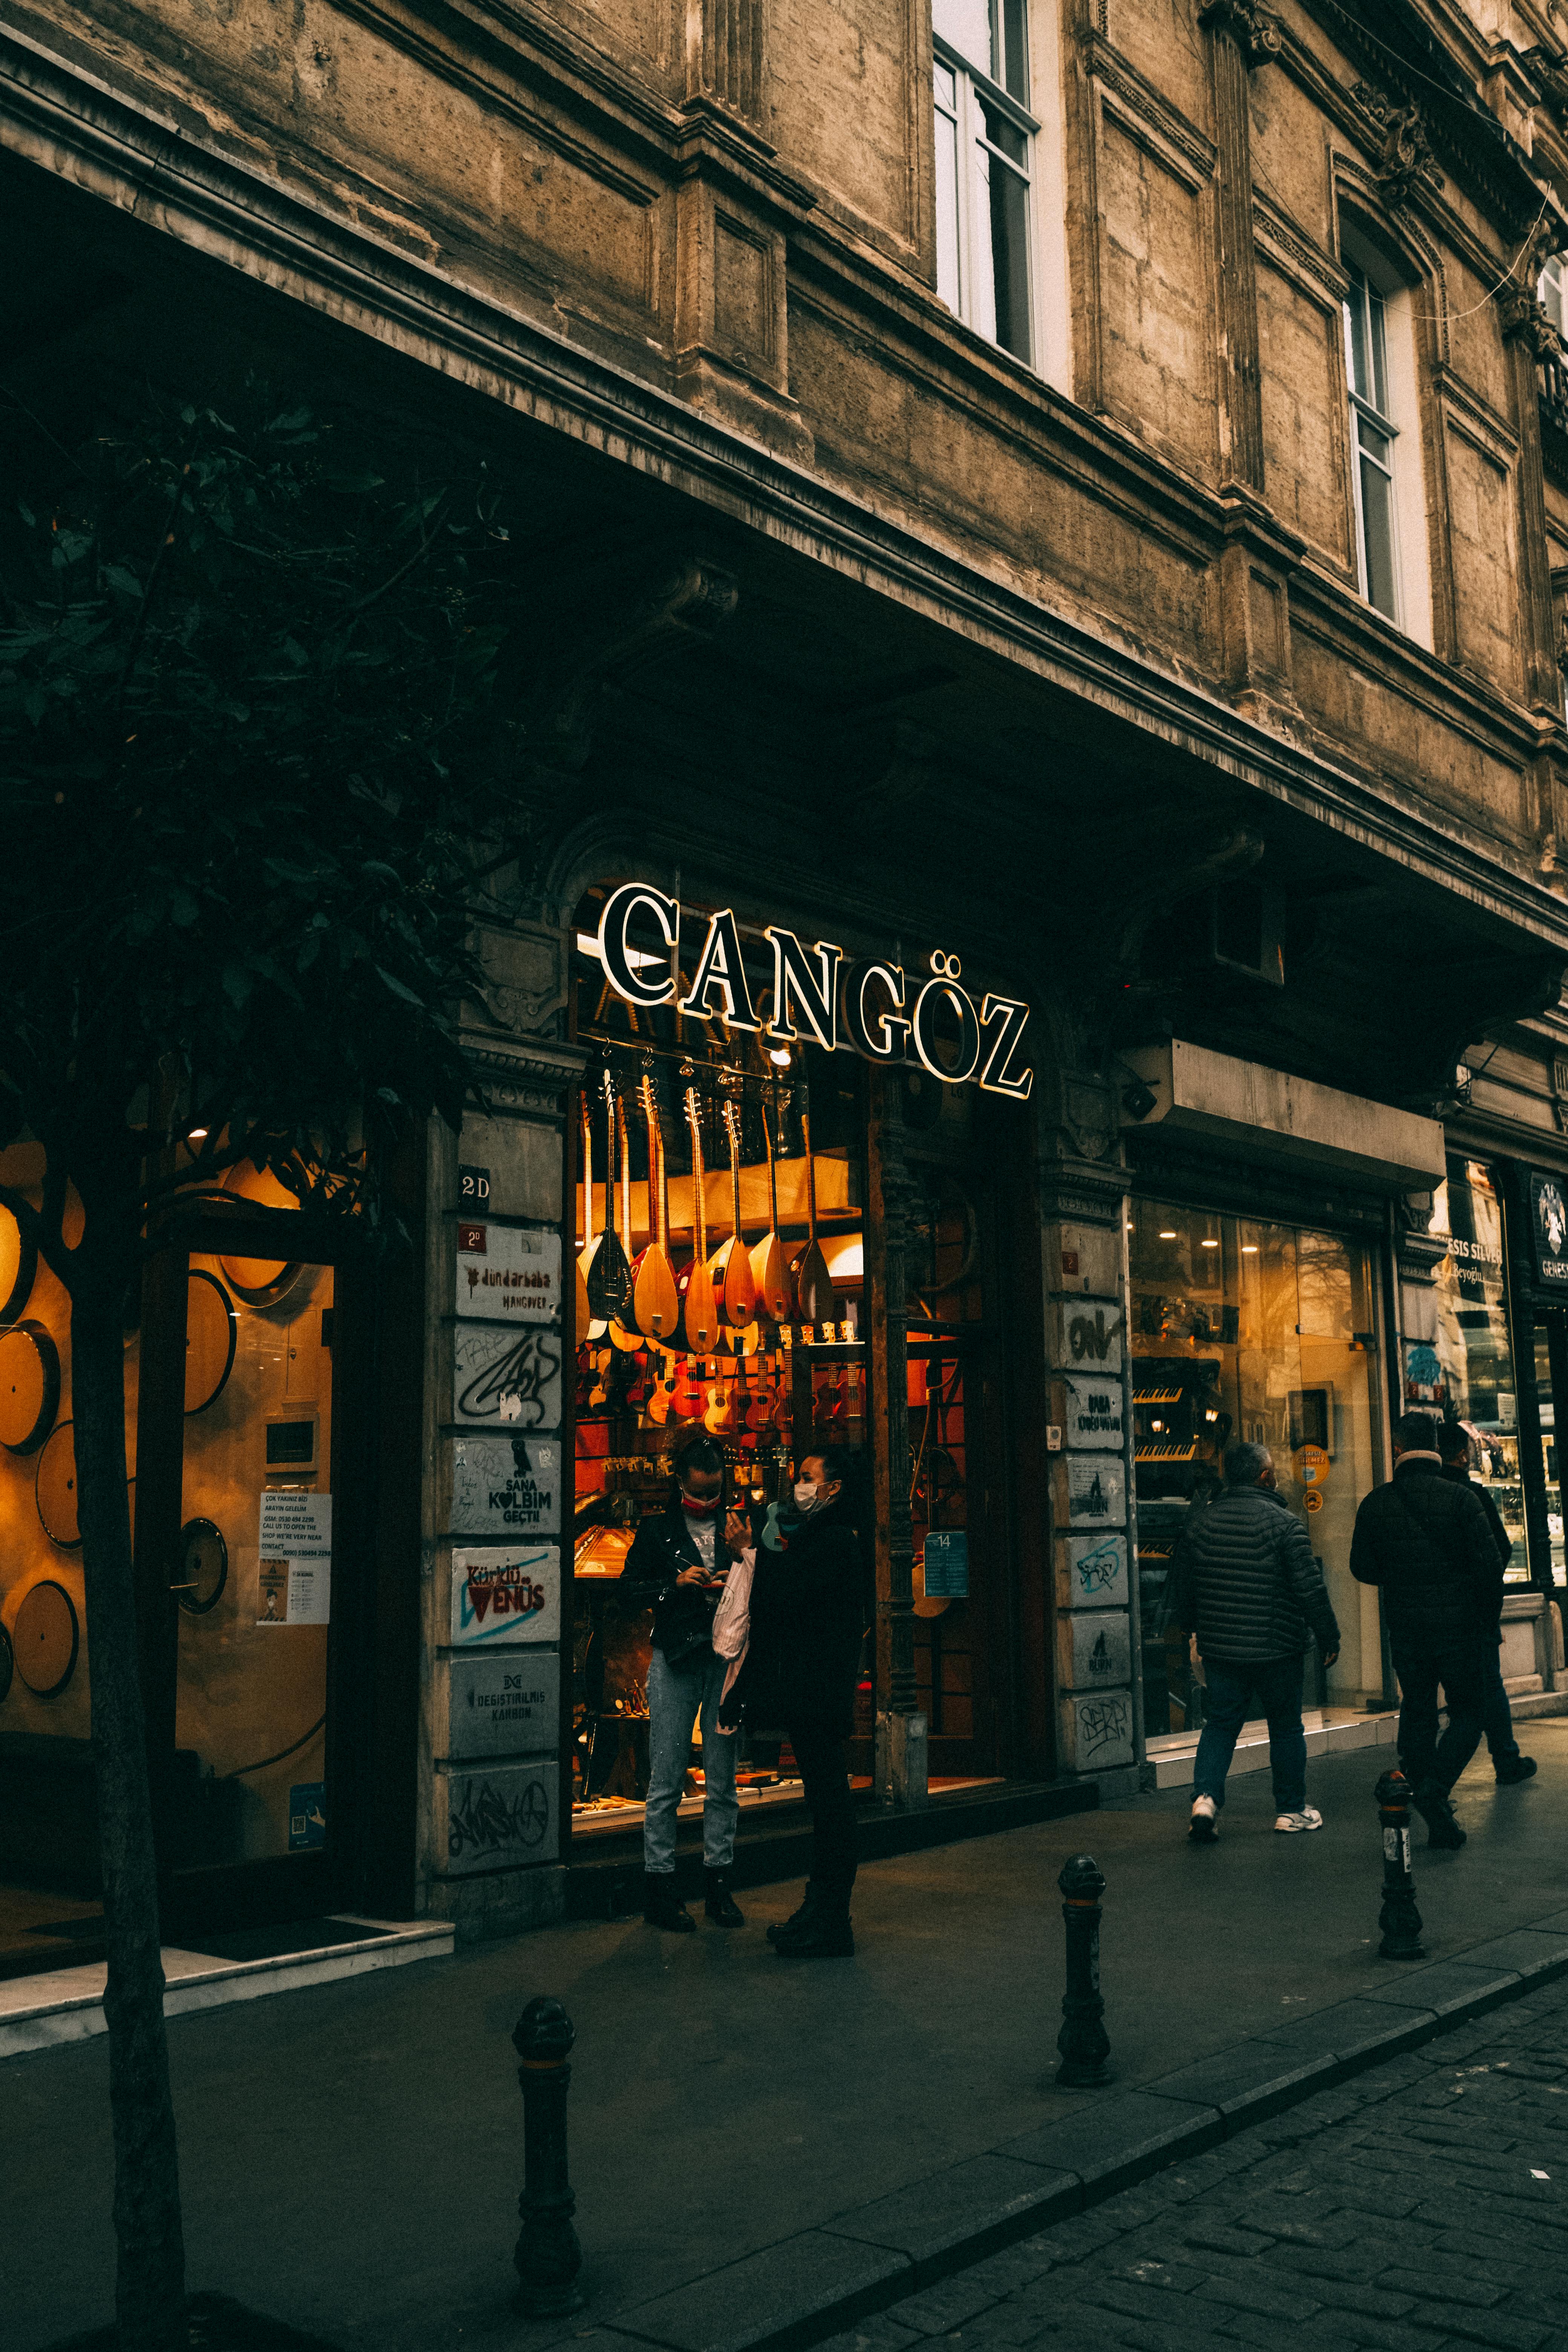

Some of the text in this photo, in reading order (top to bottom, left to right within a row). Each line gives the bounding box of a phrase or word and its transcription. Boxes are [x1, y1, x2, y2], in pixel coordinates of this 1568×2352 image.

[462, 1176, 490, 1198] 2D
[1471, 1243, 1502, 1264] SILVER
[1453, 1262, 1482, 1285] Beyoğlu
[503, 1295, 547, 1310] HANGOVER
[506, 1479, 537, 1491] SANA
[937, 1535, 951, 1547] 14
[467, 1565, 521, 1585] Kürklü
